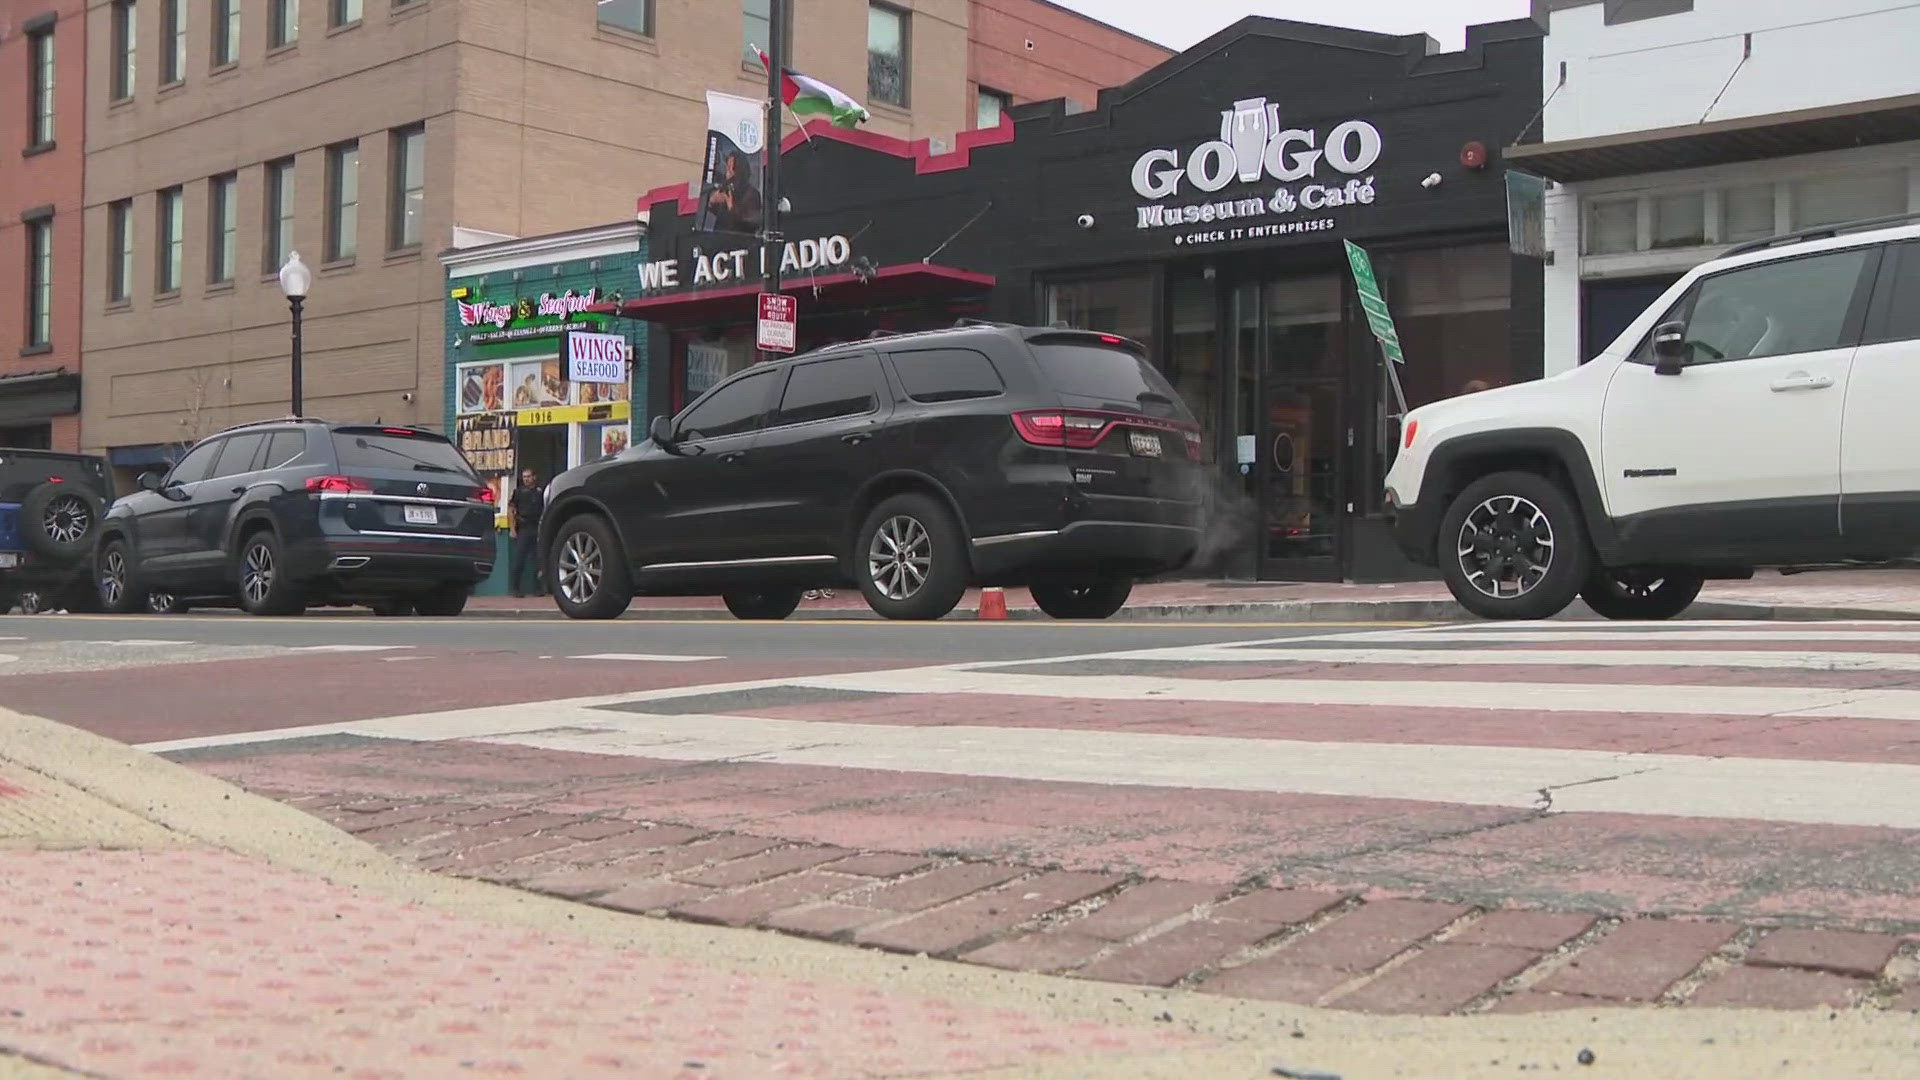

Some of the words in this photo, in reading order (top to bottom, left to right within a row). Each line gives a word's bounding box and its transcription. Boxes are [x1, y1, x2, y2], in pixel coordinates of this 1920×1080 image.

[1136, 196, 1266, 229] Museum
[1268, 187, 1297, 213] &
[1299, 175, 1376, 210] Café
[1186, 230, 1225, 245] CHECK
[1230, 227, 1244, 240] IT
[1248, 218, 1335, 238] ENTERPRISES
[637, 258, 680, 290] WE
[693, 249, 749, 285] ACT
[760, 234, 851, 275] ADIO
[572, 336, 623, 362] WINGS
[576, 361, 618, 378] SEAFOOD
[530, 411, 553, 423] 1916
